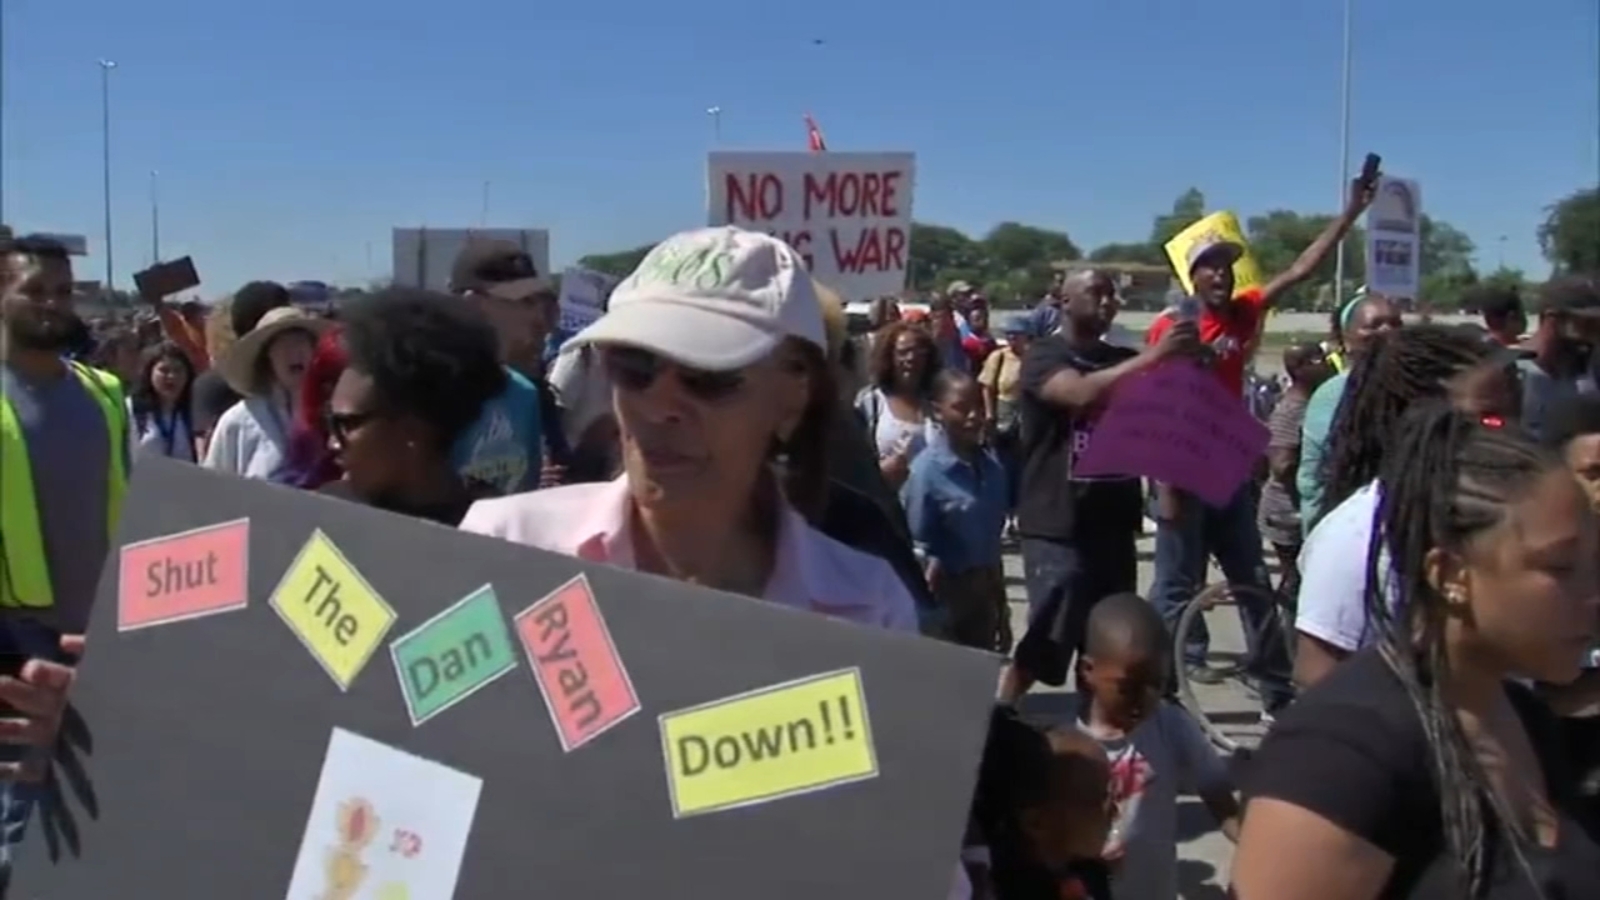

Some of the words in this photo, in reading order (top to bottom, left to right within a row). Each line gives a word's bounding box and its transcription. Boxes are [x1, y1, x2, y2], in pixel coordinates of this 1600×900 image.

[725, 173, 784, 225] NO
[803, 170, 903, 221] MORE
[829, 226, 907, 275] WAR
[146, 550, 218, 598] Shut
[302, 565, 359, 646] The
[407, 630, 493, 700] Dan
[534, 602, 604, 730] Ryan
[678, 695, 856, 777] Down!!
